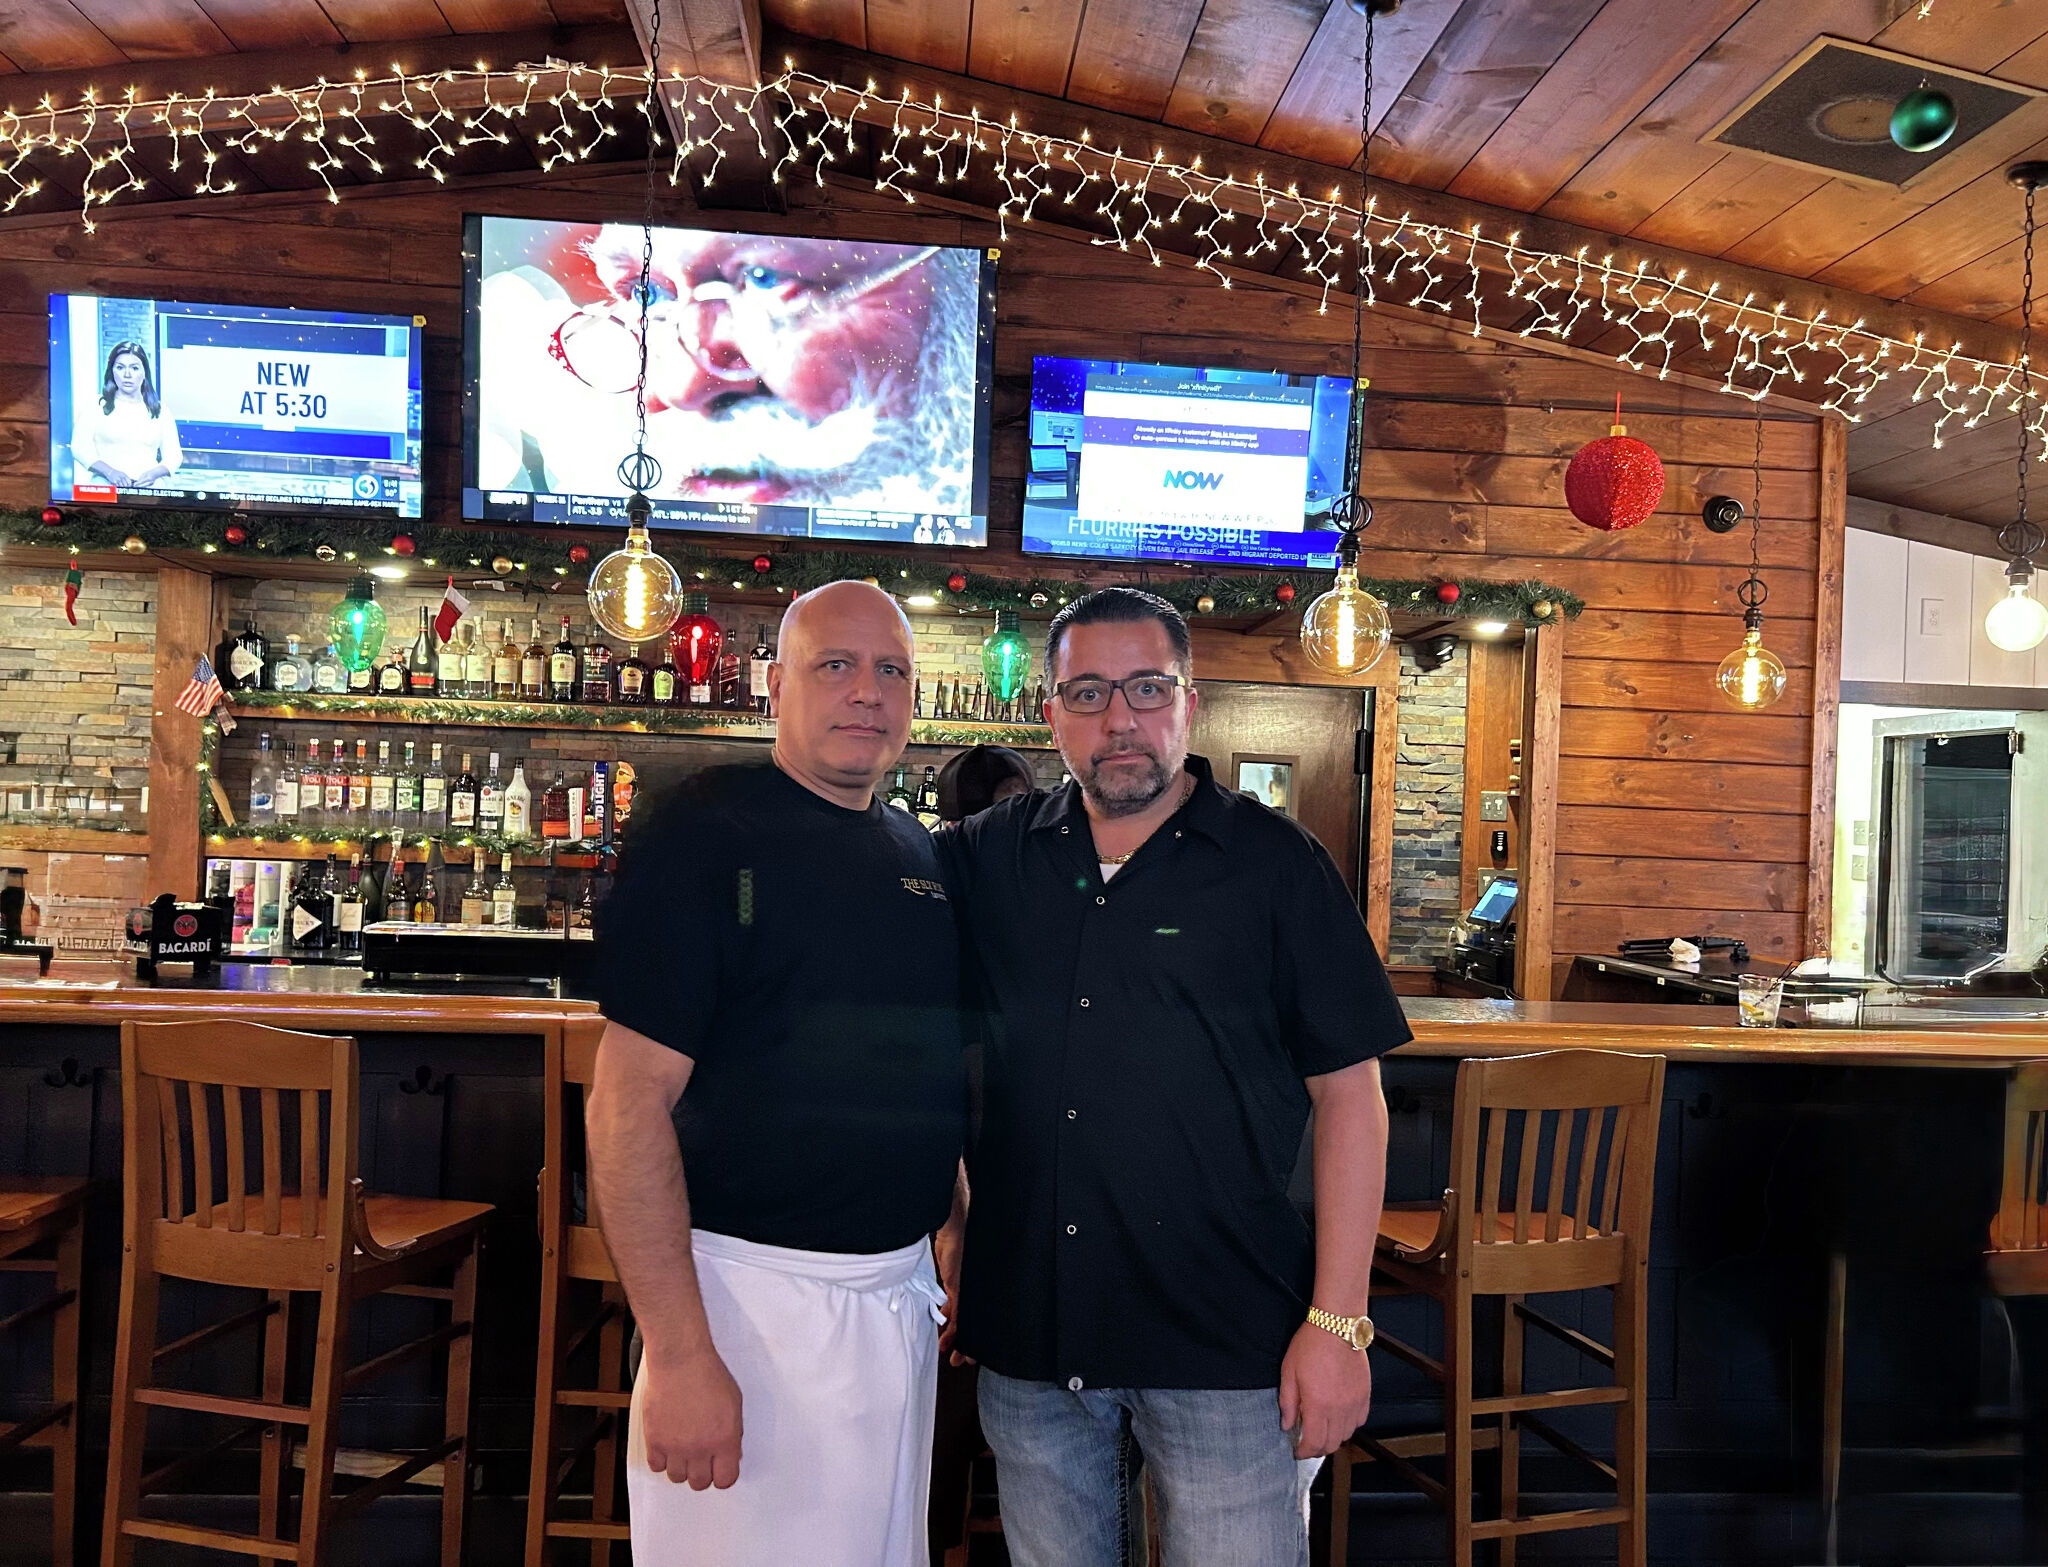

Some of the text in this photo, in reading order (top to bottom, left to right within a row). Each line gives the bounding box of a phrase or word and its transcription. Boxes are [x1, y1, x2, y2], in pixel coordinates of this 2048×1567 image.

[257, 361, 310, 387] NEW
[240, 391, 327, 418] AT 5:30
[1163, 469, 1224, 491] NOW
[153, 489, 185, 498] ELECTIONS
[219, 493, 246, 501] SUPREME
[247, 494, 265, 502] COURT
[266, 495, 293, 503] DECLINES
[572, 495, 610, 506] Panthers
[612, 499, 622, 507] vs
[573, 506, 587, 515] ATL
[652, 510, 670, 519] ATL:
[688, 512, 701, 521] FPI
[702, 513, 728, 522] chance
[728, 514, 737, 523] to
[1068, 515, 1261, 545] FLURRIES POSSIBLE
[1051, 539, 1071, 547] WORLD
[1071, 540, 1088, 548] NEWS:
[1138, 544, 1156, 552] GIVEN
[1157, 545, 1176, 553] EARLY
[1176, 546, 1192, 554] JAIL
[1192, 547, 1215, 556] RELEASE
[1269, 552, 1300, 560] DEPORTED
[594, 772, 605, 805] LIGHT
[159, 938, 212, 954] BACARDÍ
